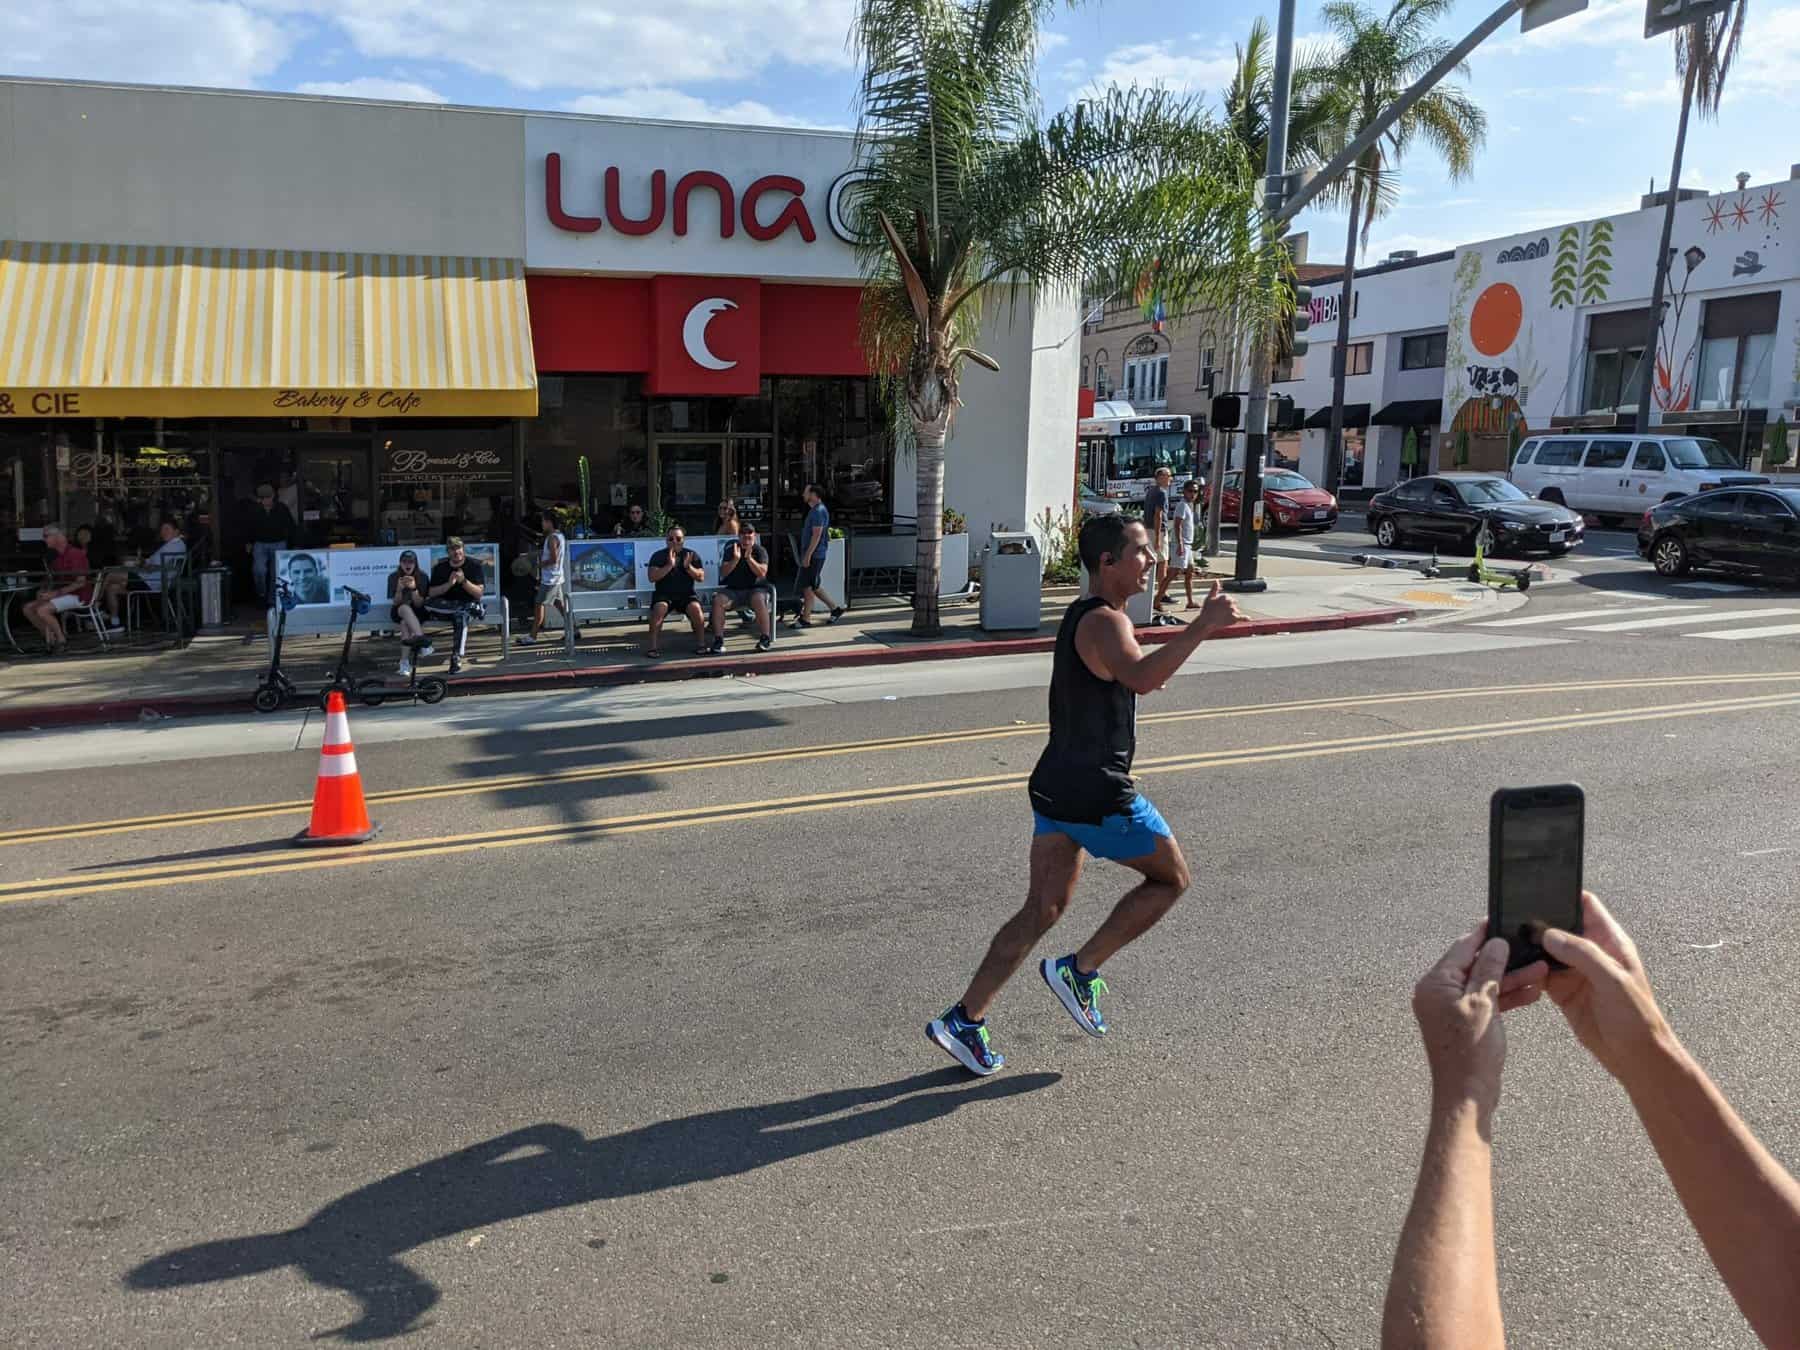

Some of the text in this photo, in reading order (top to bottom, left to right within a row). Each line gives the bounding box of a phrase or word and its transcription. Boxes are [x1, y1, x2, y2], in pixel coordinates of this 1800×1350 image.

[0, 392, 80, 414] & CIE
[273, 391, 422, 414] Bakery & Cafe
[1123, 421, 1173, 432] 3 EUCLID AVE TC
